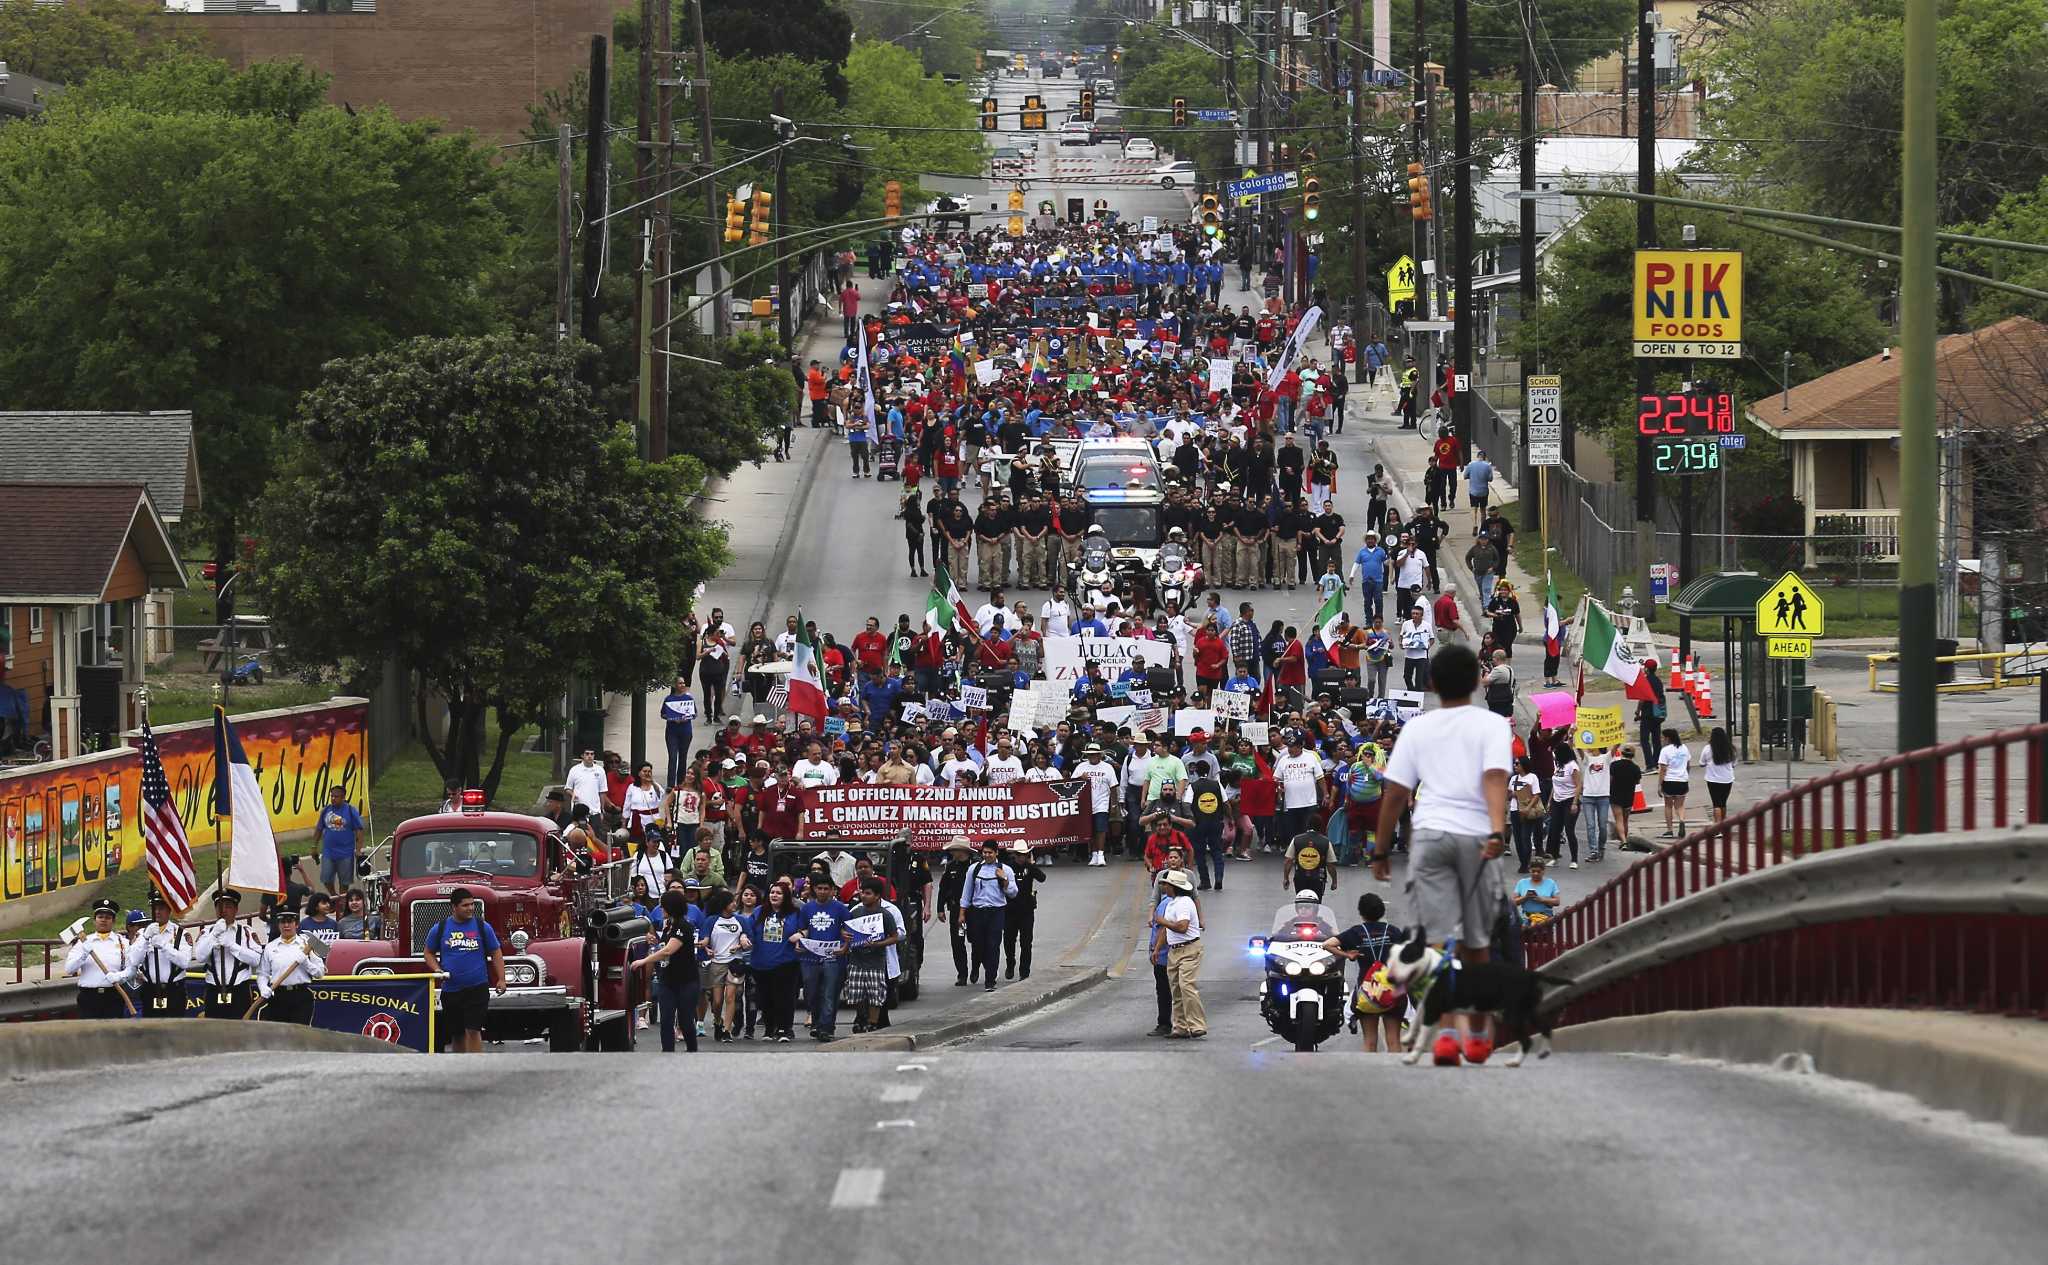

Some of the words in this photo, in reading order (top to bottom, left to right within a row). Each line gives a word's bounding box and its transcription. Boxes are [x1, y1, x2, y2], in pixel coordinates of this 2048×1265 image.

[1240, 175, 1284, 189] Colorado
[1651, 324, 1723, 337] FOODS
[1641, 344, 1676, 354] OPEN
[1683, 344, 1690, 354] 6
[1700, 344, 1716, 354] TO
[1721, 345, 1735, 355] 12
[1532, 408, 1557, 423] 20
[1719, 436, 1744, 447] chter
[1656, 443, 1706, 471] 2.79
[1077, 644, 1138, 658] LULAC
[1773, 643, 1807, 653] AHEAD
[817, 789, 845, 802] THE
[848, 788, 912, 801] OFFICIAL
[915, 788, 955, 800] 22ND
[958, 787, 1013, 800] ANNUAL
[814, 808, 828, 823] E.
[832, 806, 899, 822] CHAVEZ
[903, 806, 968, 821] MARCH
[972, 806, 1004, 821] FOR
[1008, 800, 1080, 820] JUSTICE
[809, 829, 850, 838] GRD
[852, 828, 900, 836] MARSHA
[980, 827, 1026, 835] CHAVEZ
[828, 822, 888, 830] CO-SPONSORED
[450, 931, 464, 940] YO
[312, 990, 420, 1015] ROFESSIONAL
